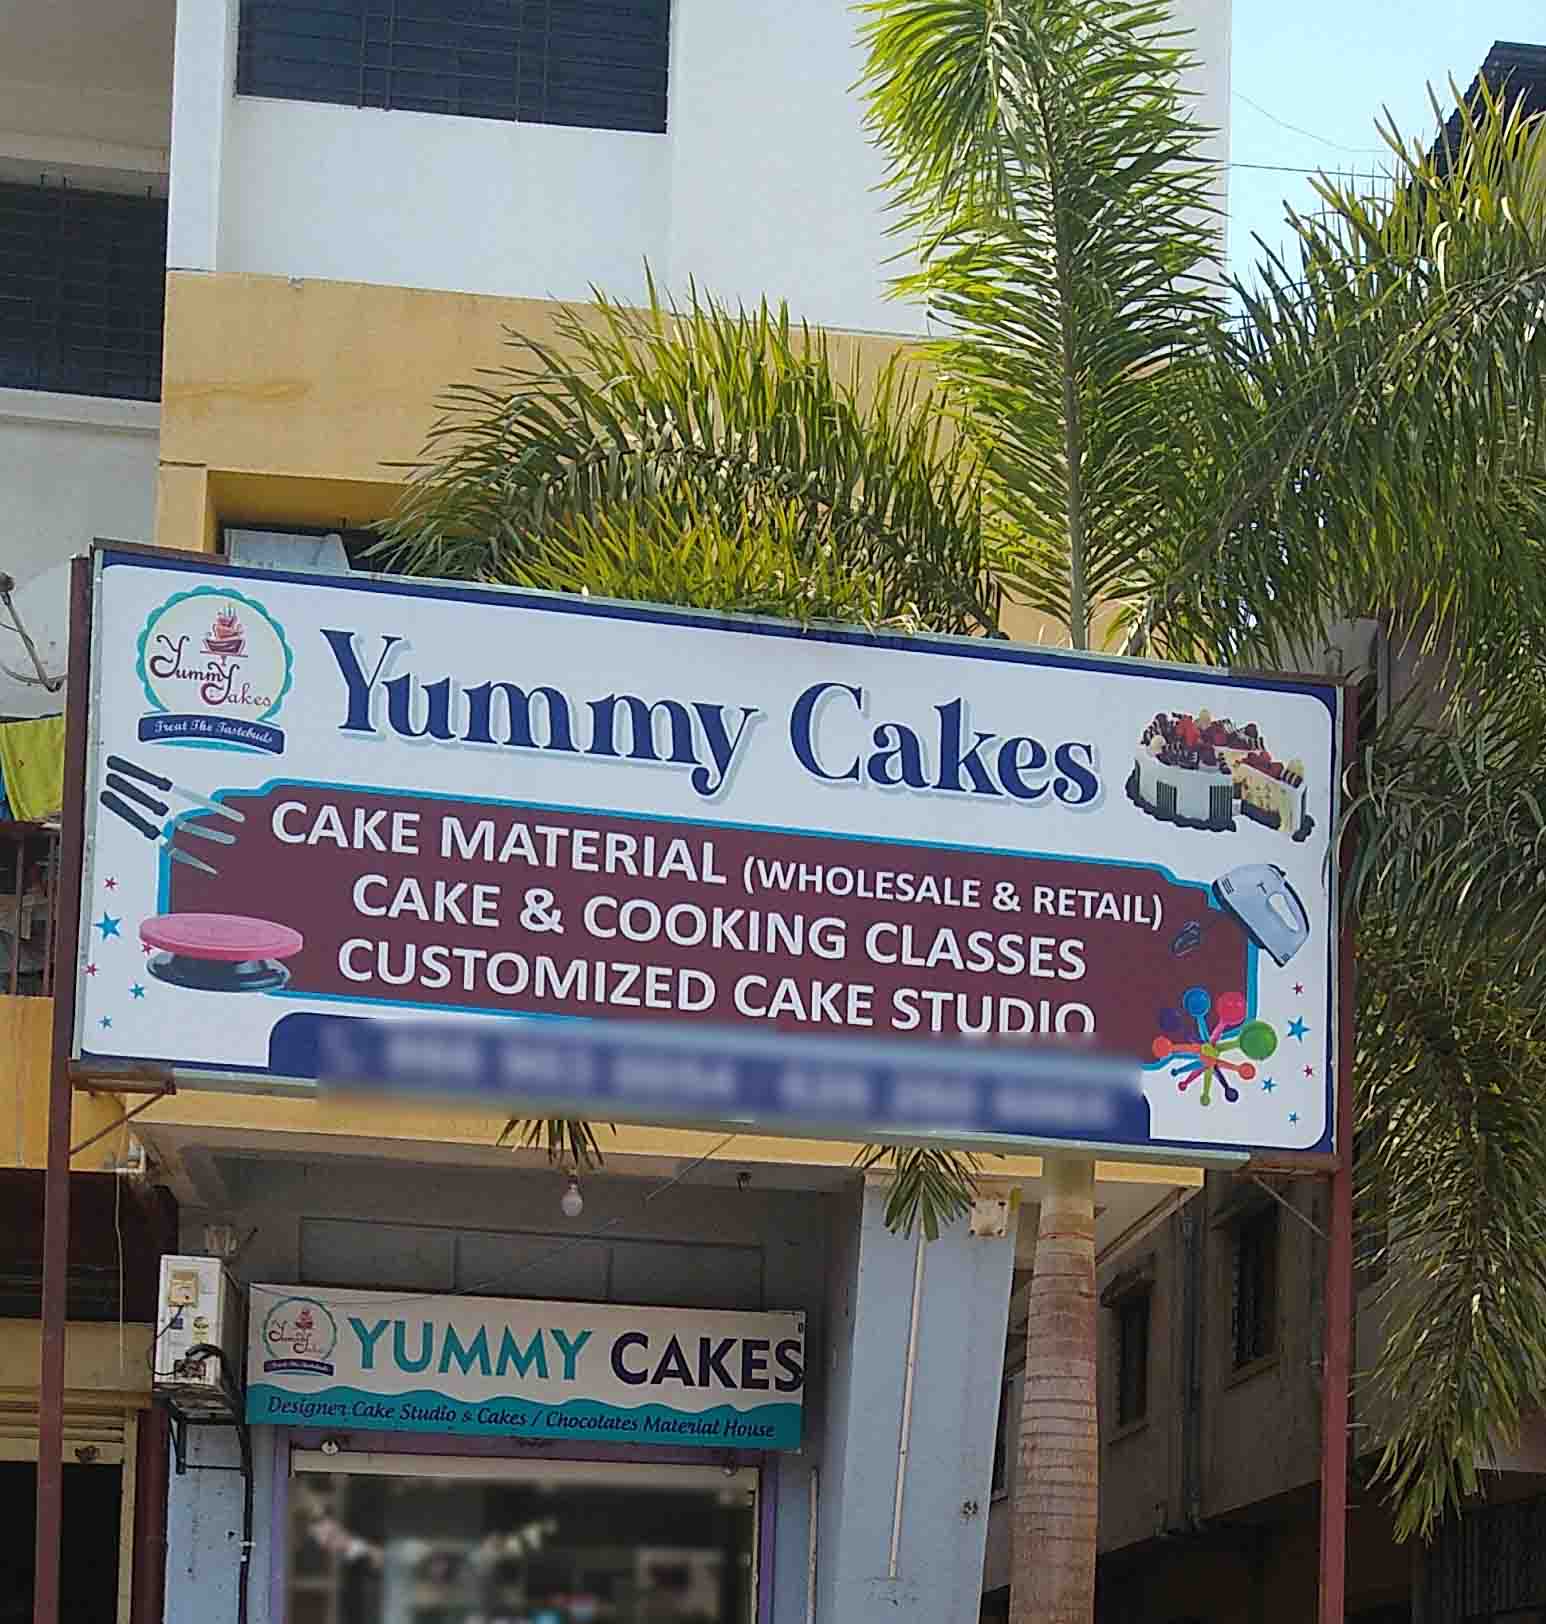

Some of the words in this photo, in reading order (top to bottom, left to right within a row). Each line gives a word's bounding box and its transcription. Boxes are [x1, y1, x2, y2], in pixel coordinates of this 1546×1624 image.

[320, 628, 758, 796] Yummy
[789, 681, 1100, 805] Cakes
[271, 801, 420, 855] CAKE
[441, 816, 727, 885] MATERIAL
[743, 856, 981, 908] (WHOLESALE
[992, 881, 1021, 912] &
[1032, 886, 1163, 930] RETAIL)
[353, 874, 499, 928] CAKE
[519, 887, 564, 934] &
[583, 895, 847, 960] COOKING
[865, 922, 1087, 980] CLASSES
[338, 939, 715, 1012] CUSTOMIZED
[733, 975, 874, 1026] CAKE
[891, 986, 1097, 1034] STUDIO
[348, 1317, 593, 1380] YUMMY
[610, 1332, 804, 1393] CAKES
[268, 1396, 346, 1419] Designer
[352, 1401, 395, 1419] Cake
[399, 1403, 457, 1423] Studio
[477, 1407, 528, 1426] Cakes
[546, 1410, 639, 1431] Chocolates
[643, 1415, 720, 1435] Material
[723, 1420, 776, 1438] House
